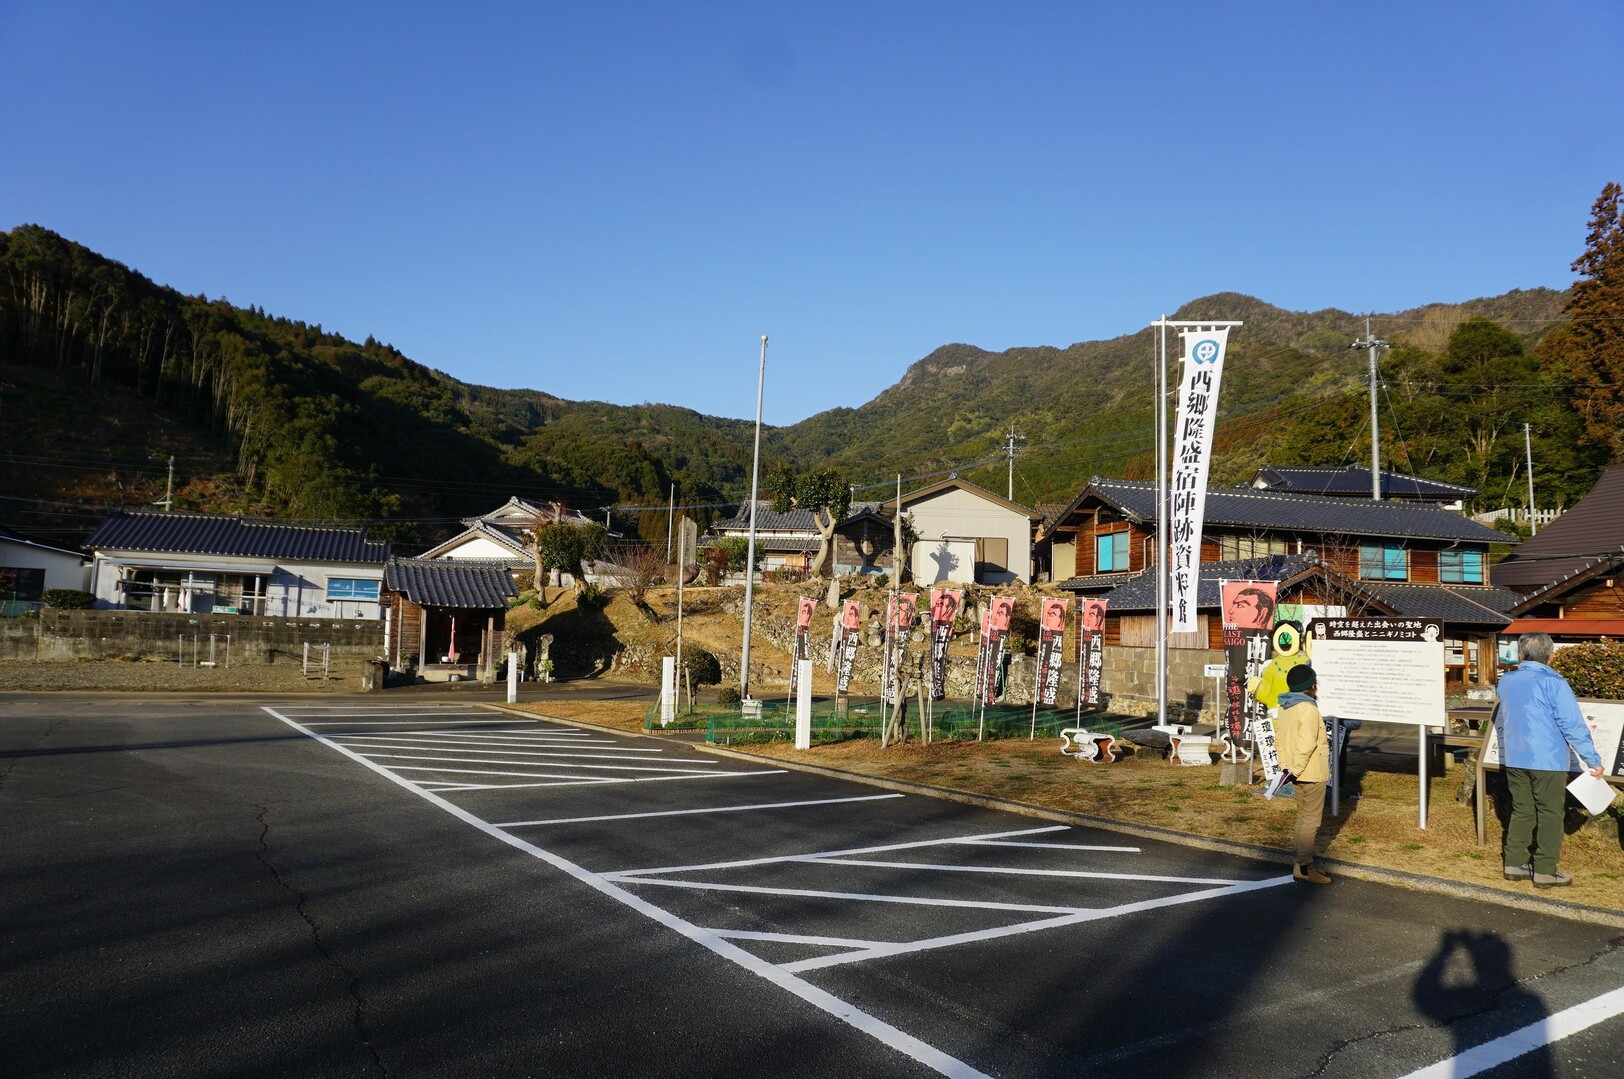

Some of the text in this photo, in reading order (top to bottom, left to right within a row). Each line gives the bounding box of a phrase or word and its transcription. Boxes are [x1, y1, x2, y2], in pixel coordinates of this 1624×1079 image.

[1329, 620, 1422, 629] 時空を超えた出会いの聖地
[1224, 630, 1242, 638] LAST
[1333, 629, 1417, 638] 西郷隆盛とニニギノミコト
[1224, 637, 1246, 646] SAIGO
[1043, 634, 1063, 705] 西郷隆盛
[1088, 634, 1102, 704] 西郷隆盛
